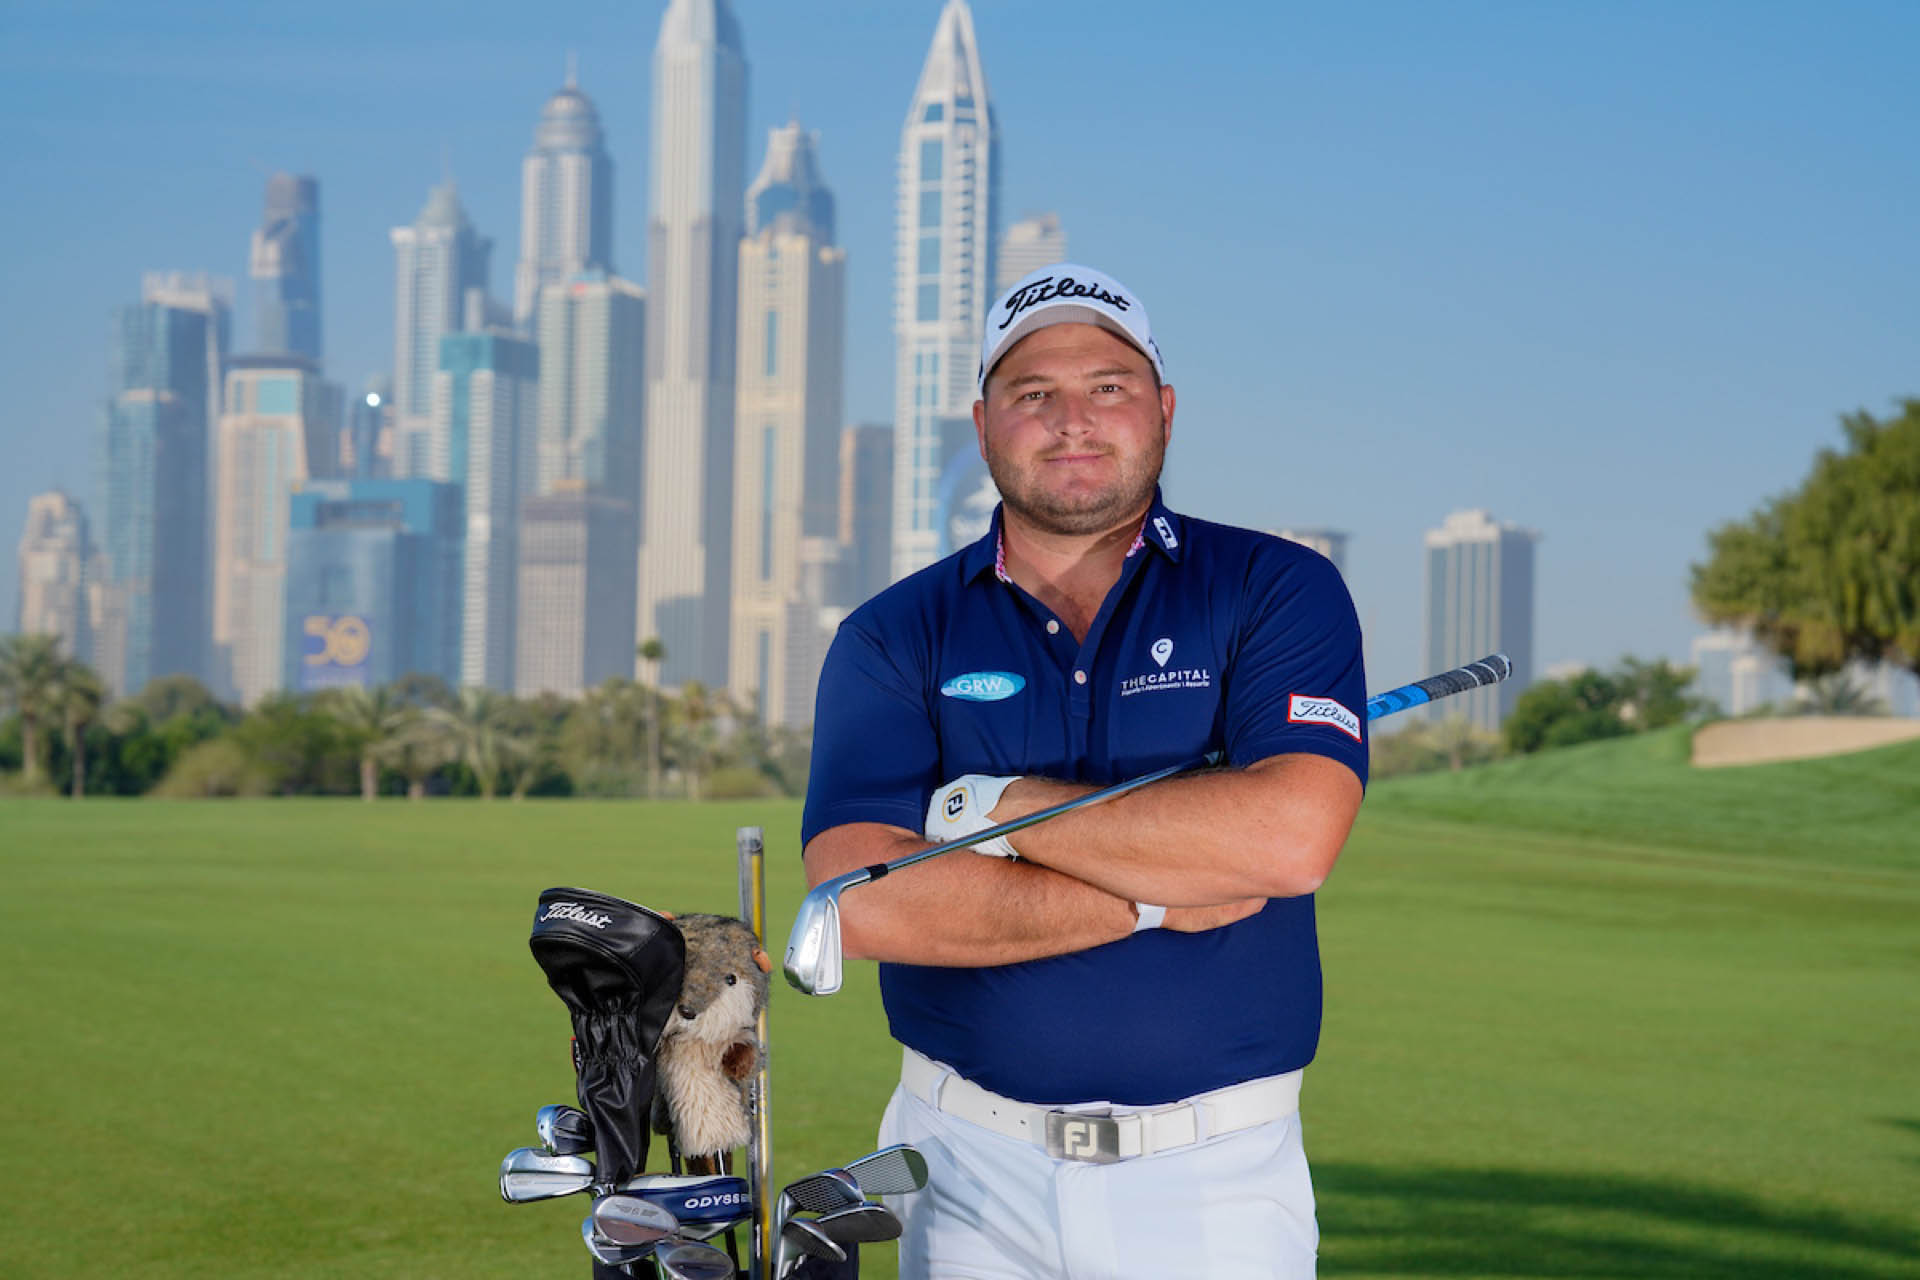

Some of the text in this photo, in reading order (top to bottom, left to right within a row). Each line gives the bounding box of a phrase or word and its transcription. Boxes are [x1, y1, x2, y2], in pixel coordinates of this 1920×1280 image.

[998, 276, 1131, 330] Titleist
[956, 677, 1002, 694] GRW
[1293, 700, 1358, 732] Titleist
[540, 902, 612, 929] Titleist
[1064, 1121, 1097, 1158] FJ
